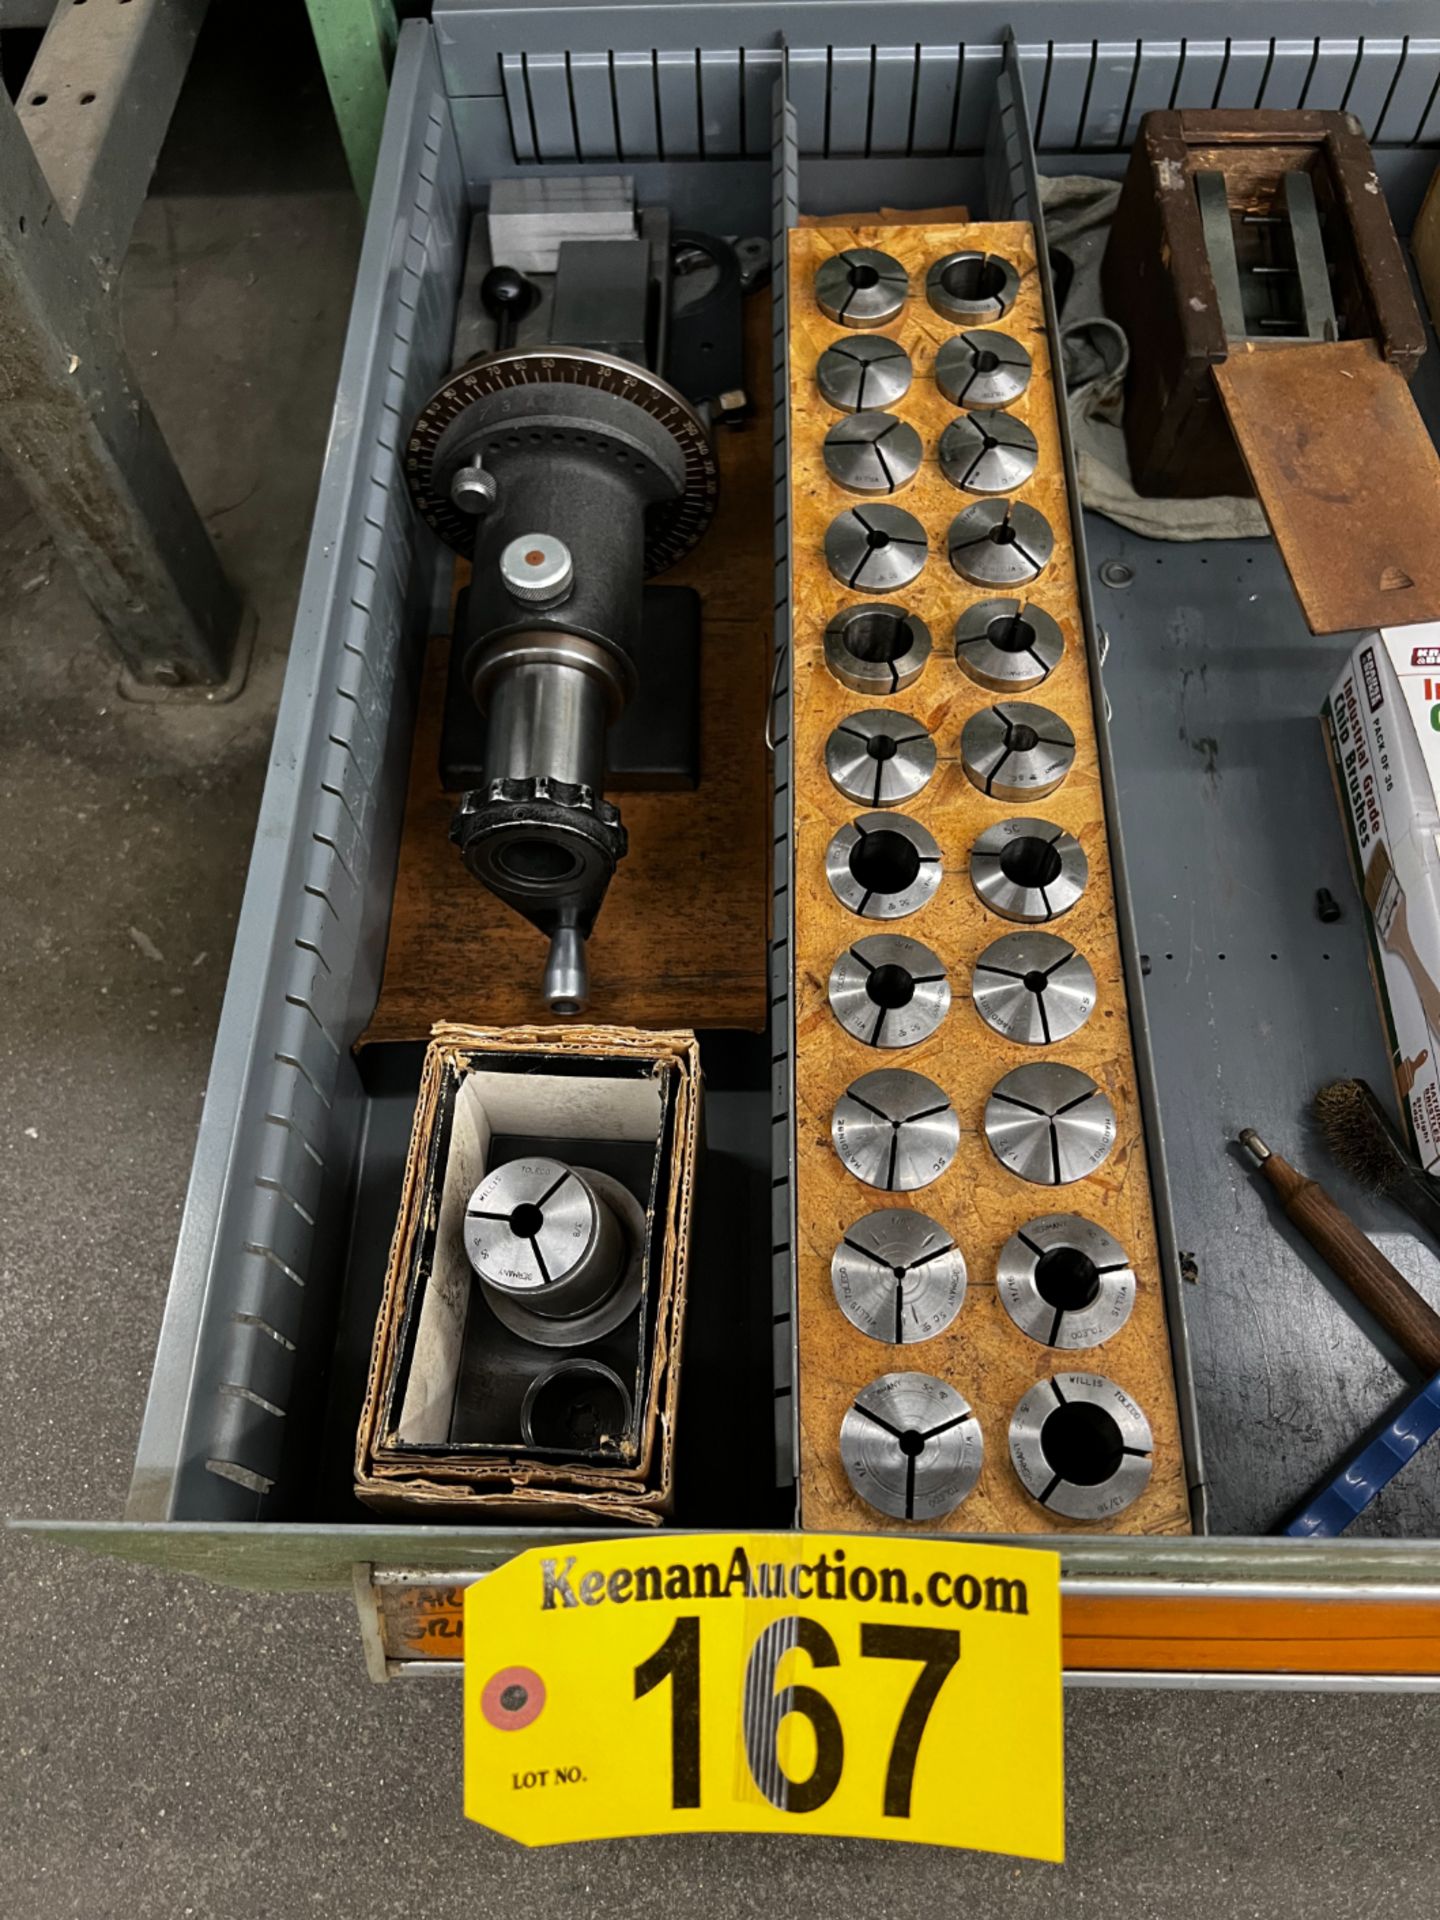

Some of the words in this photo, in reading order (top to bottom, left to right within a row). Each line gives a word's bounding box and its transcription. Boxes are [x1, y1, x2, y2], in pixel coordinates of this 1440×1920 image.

[486, 366, 501, 376] 70
[597, 366, 612, 377] 30
[623, 375, 638, 387] 20
[670, 406, 679, 415] 0
[1343, 676, 1369, 770] Industrial
[1363, 774, 1381, 835] Grade
[1373, 718, 1386, 753] PACK
[1380, 754, 1390, 772] OF
[1334, 693, 1350, 745] Chip
[1345, 749, 1370, 849] Brushes
[1069, 1377, 1103, 1389] WILLIS
[541, 1546, 1029, 1615] KeenanAuction.com
[633, 1615, 961, 1818] 167
[512, 1770, 549, 1790] LOT
[554, 1768, 588, 1786] NO.
